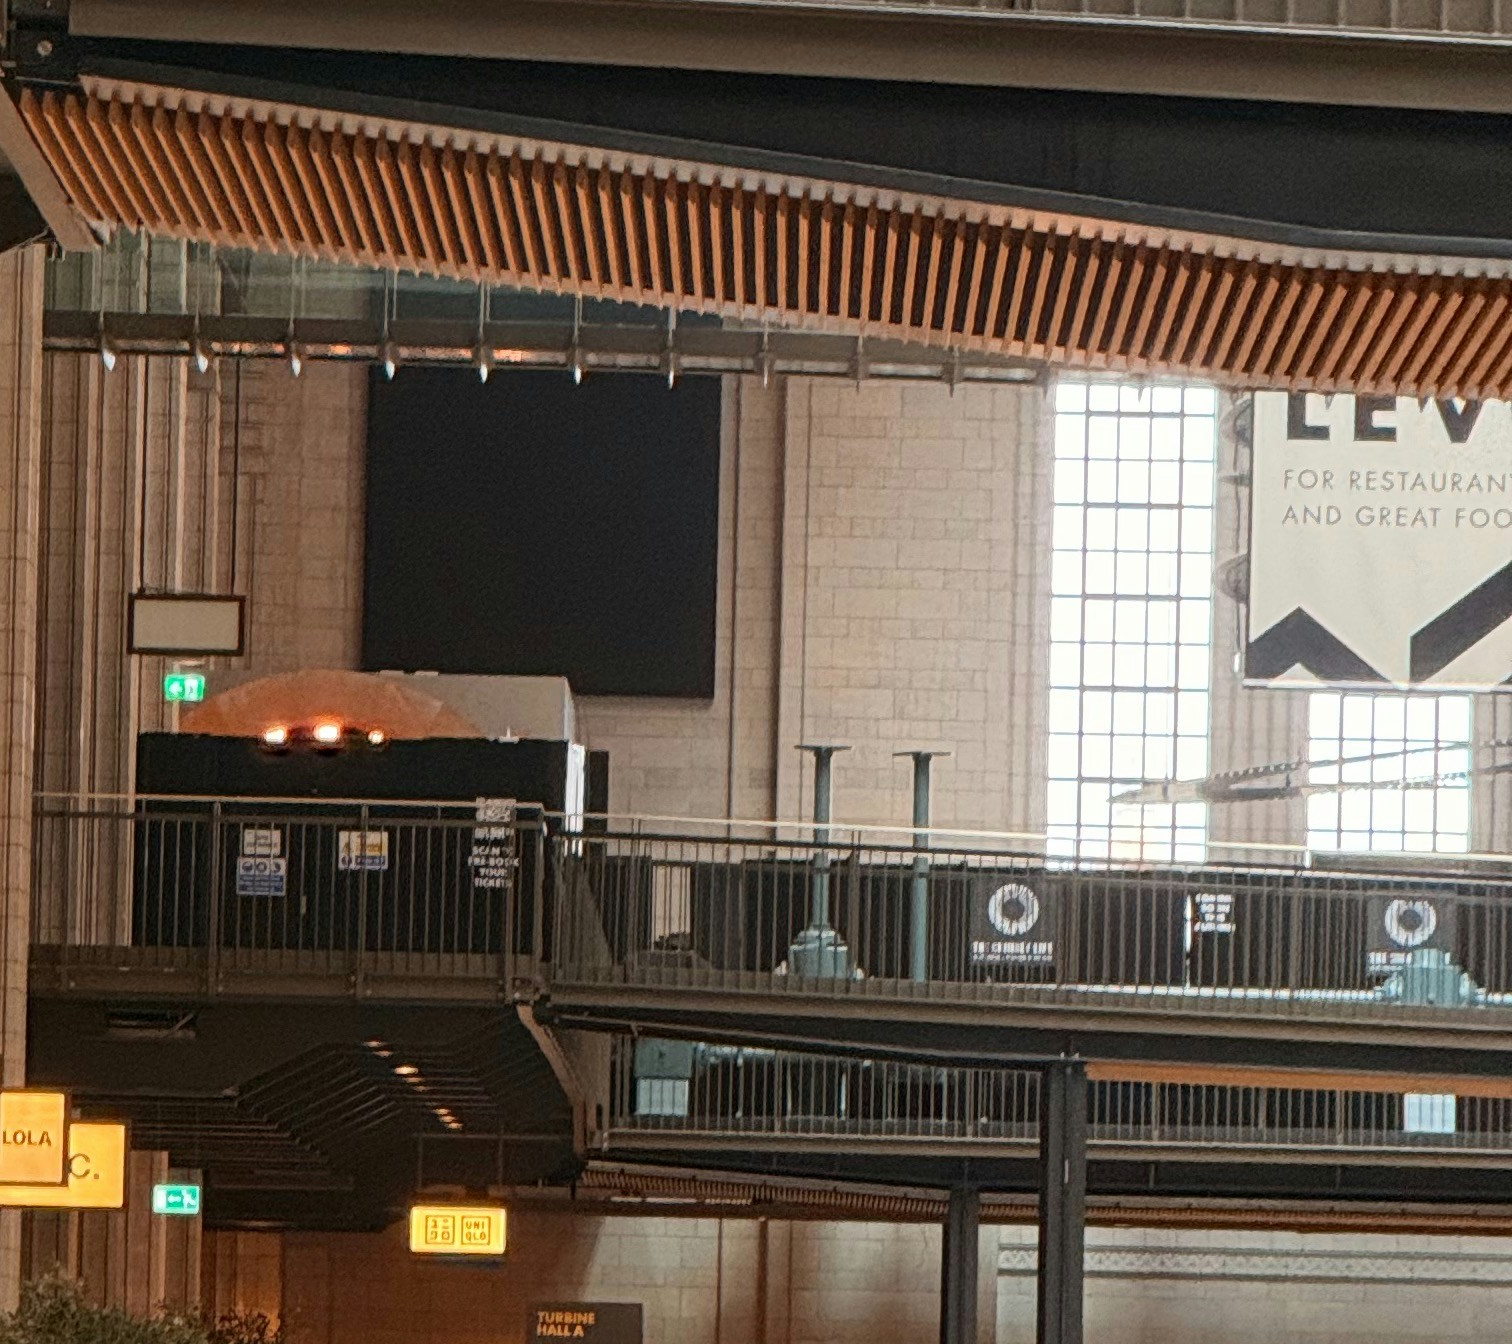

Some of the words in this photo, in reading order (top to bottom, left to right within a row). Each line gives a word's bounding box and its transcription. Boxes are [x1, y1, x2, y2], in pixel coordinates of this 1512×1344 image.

[1283, 468, 1335, 490] FOR
[1349, 469, 1512, 493] RESTAURAN
[1282, 504, 1342, 527] AND
[1355, 504, 1441, 528] GREAT
[1455, 507, 1512, 529] FOO
[2, 1129, 52, 1147] LOLA
[465, 1220, 485, 1230] UNI
[465, 1231, 486, 1242] QLO
[537, 1311, 596, 1325] TURBINE
[537, 1324, 571, 1337] HALL
[572, 1324, 585, 1337] A
